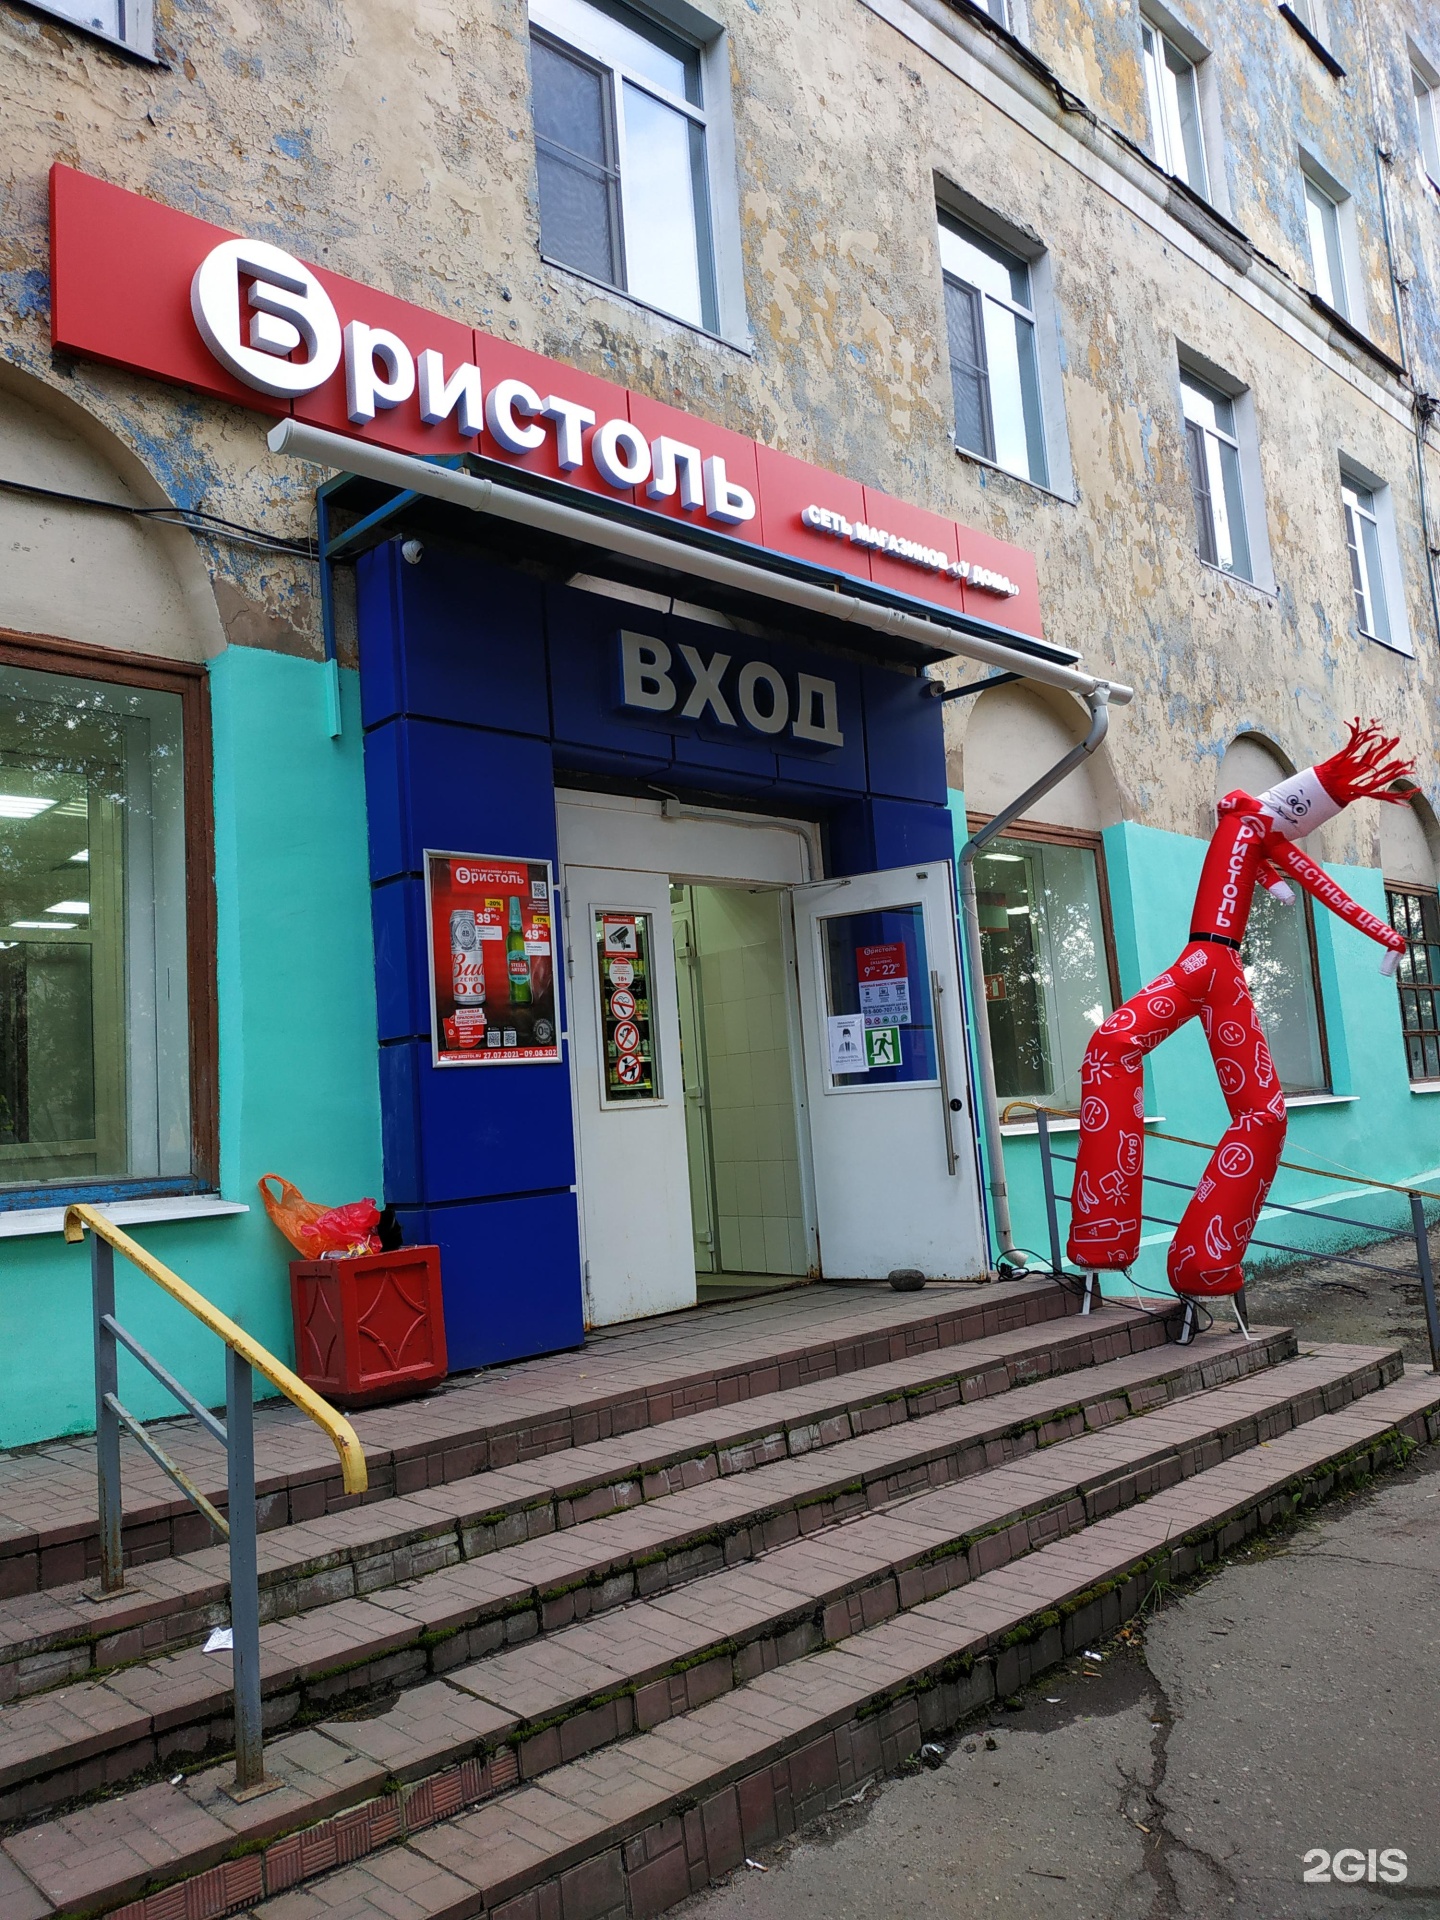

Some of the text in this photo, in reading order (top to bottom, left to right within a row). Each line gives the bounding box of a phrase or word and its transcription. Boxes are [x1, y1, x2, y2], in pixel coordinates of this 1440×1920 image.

[191, 239, 756, 526] Бристоль
[802, 505, 853, 538] СЕТЬ
[851, 522, 949, 572] МАГАЗИНОВ
[619, 629, 844, 748] ВХОД
[455, 867, 524, 884] Бристоль
[1287, 851, 1354, 916] ЧЕСТНЫЕ
[863, 946, 897, 956] Бристоль
[524, 1049, 557, 1057] 09.08.202
